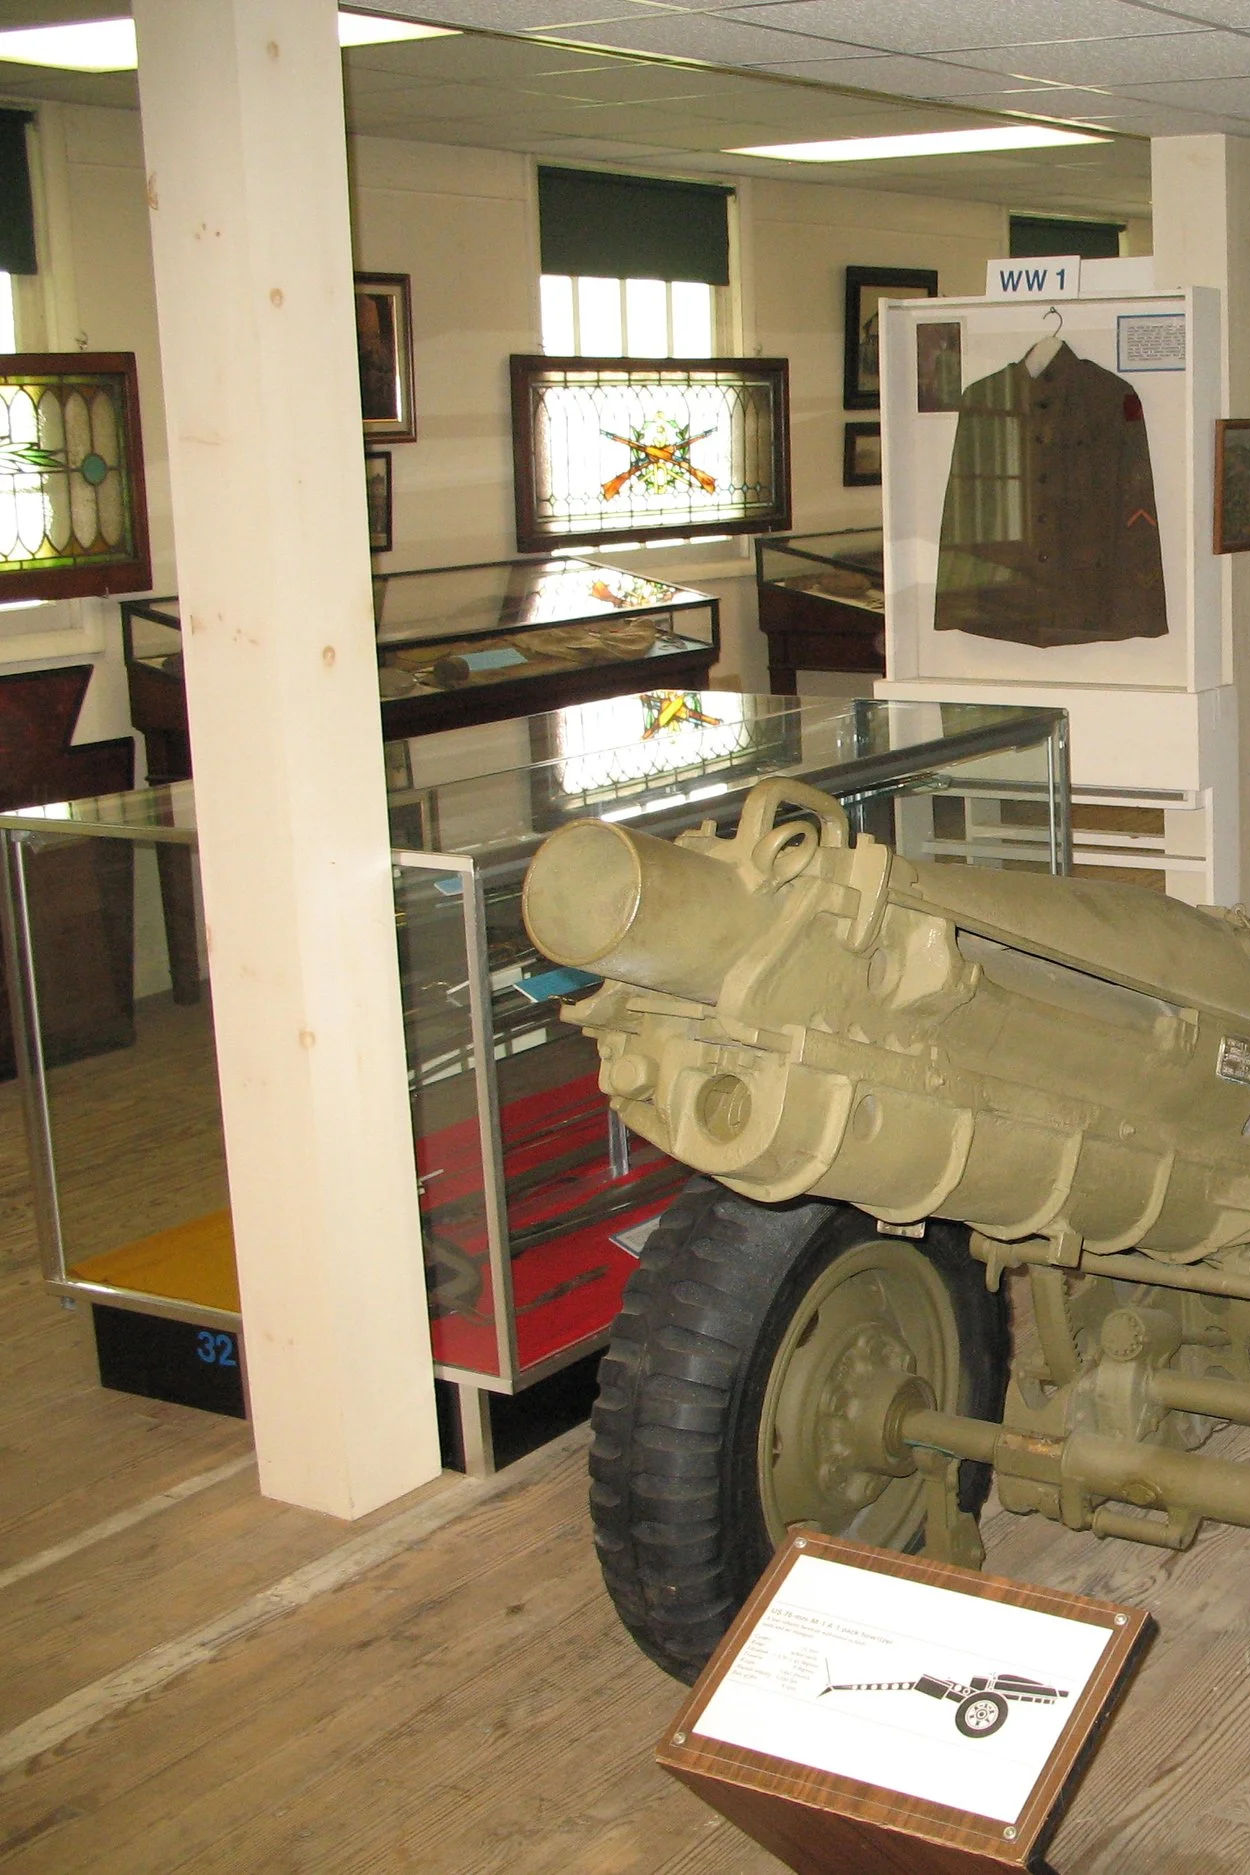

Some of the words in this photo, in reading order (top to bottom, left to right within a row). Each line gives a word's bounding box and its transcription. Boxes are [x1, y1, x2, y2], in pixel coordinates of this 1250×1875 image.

[1000, 269, 1048, 292] WW
[1056, 268, 1065, 291] 1
[197, 1331, 236, 1366] 32
